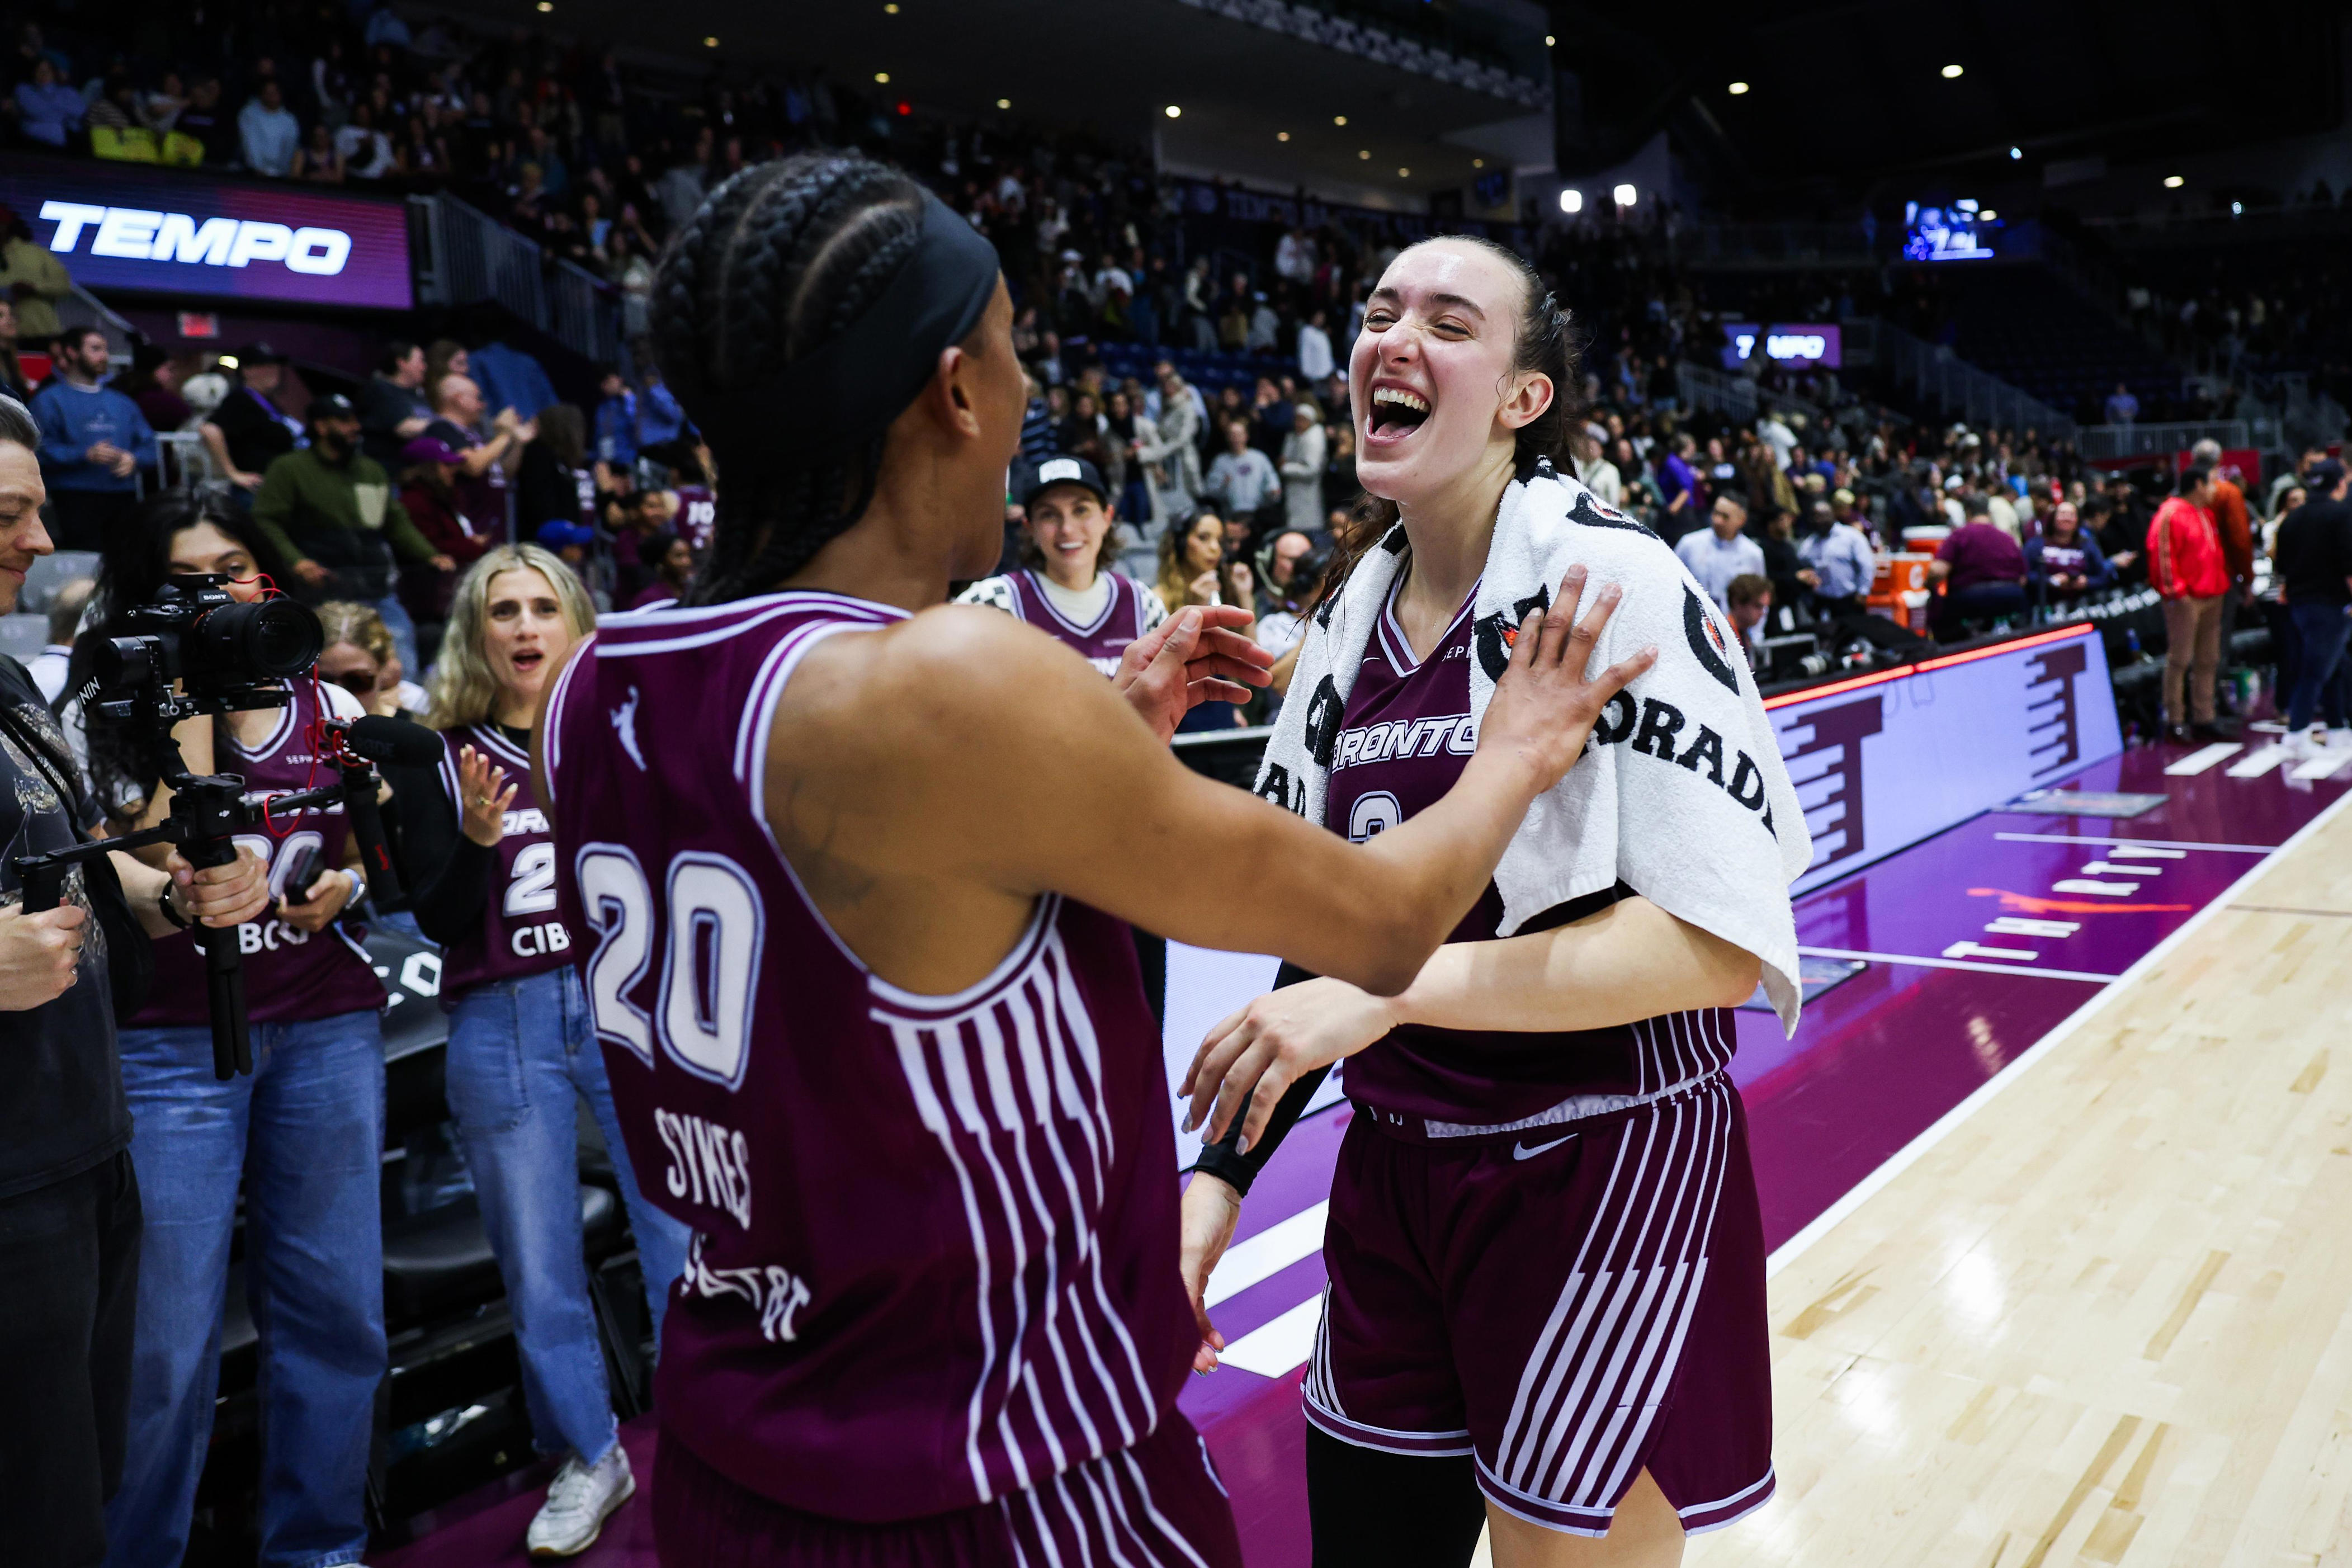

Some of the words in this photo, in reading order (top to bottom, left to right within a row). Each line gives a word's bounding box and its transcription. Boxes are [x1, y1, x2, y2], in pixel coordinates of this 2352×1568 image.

[39, 200, 352, 276] TEMPO
[1736, 335, 1825, 359] TMPO
[1578, 688, 1780, 844] ORAD
[512, 922, 572, 957] CIB
[575, 841, 766, 1093] 20
[654, 1107, 751, 1230] SYKES
